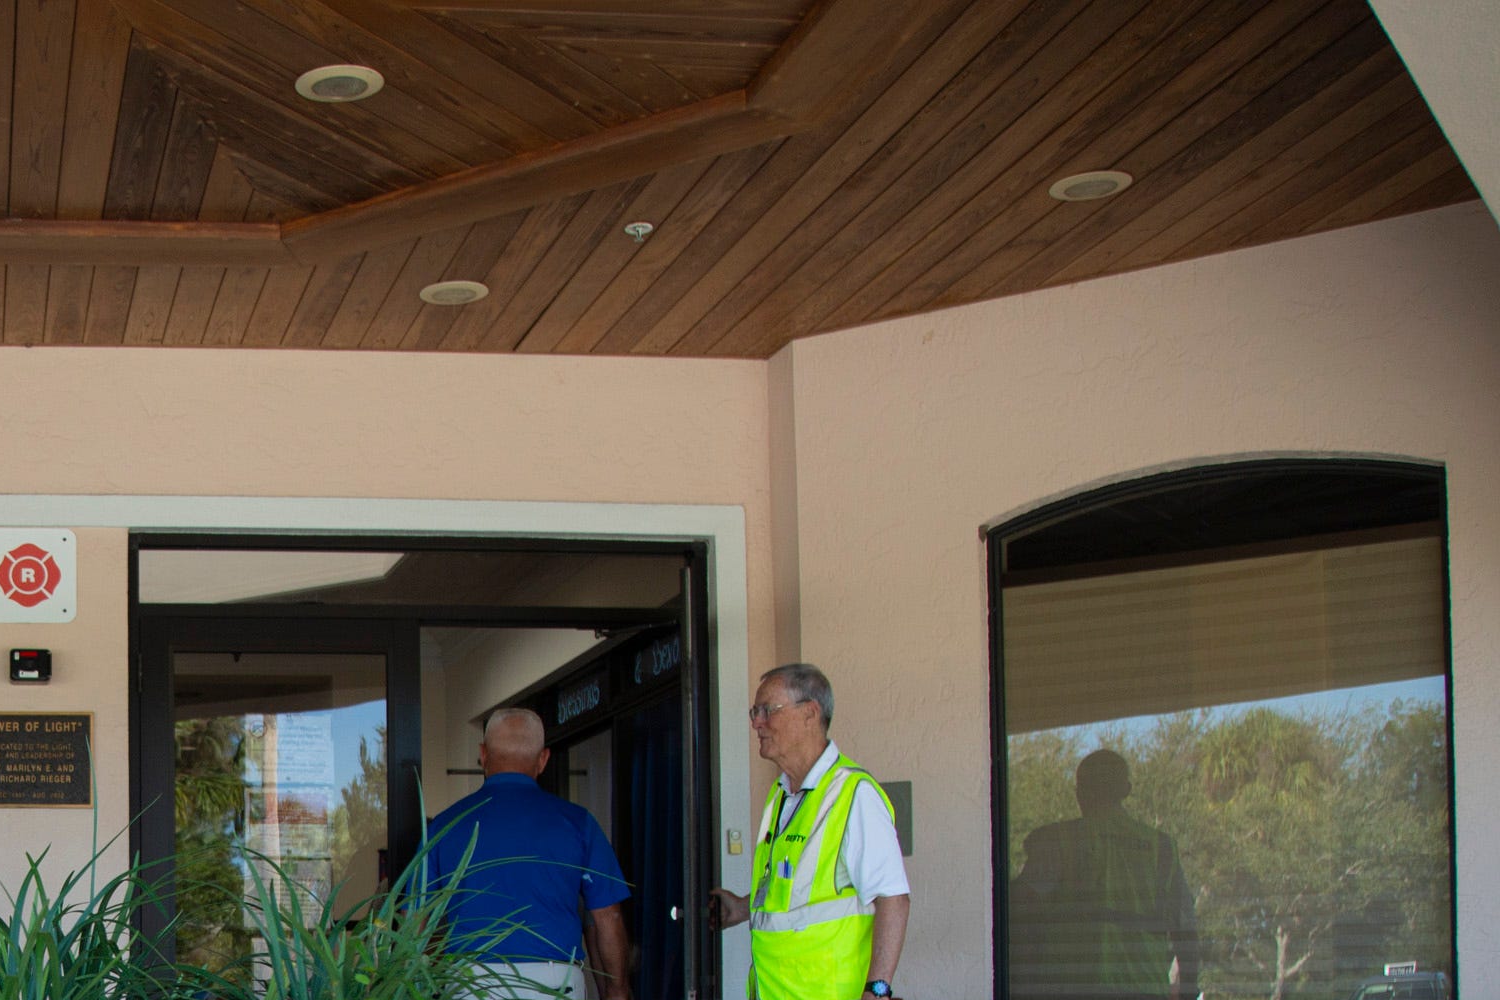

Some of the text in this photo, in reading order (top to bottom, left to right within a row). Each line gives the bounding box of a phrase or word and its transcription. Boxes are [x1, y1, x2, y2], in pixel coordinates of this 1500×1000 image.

[21, 568, 36, 583] R
[25, 721, 40, 733] OF
[25, 743, 34, 751] TO
[36, 743, 49, 751] THE
[5, 752, 19, 760] AND
[21, 752, 63, 760] LEADERSHIP
[65, 752, 75, 760] OF
[6, 764, 42, 773] MARILYN
[57, 764, 75, 773] AND
[0, 775, 37, 784] RICHARD
[40, 775, 72, 784] RIEGER
